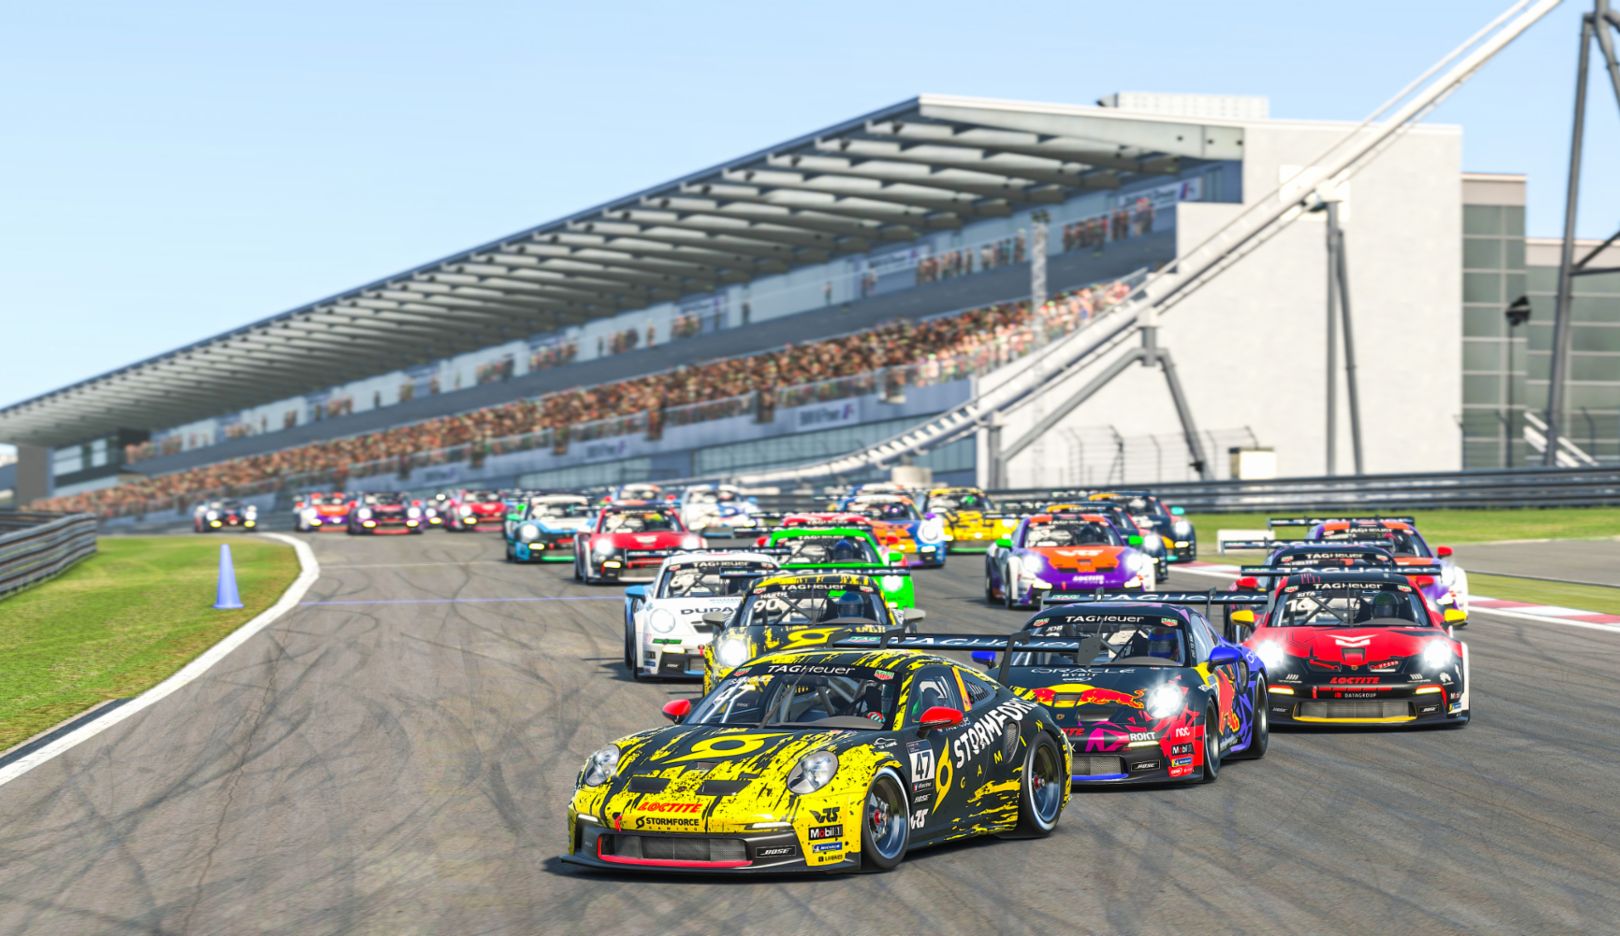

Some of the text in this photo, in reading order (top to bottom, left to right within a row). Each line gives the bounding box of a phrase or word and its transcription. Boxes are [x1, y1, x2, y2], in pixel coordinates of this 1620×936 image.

[1329, 677, 1381, 685] LOCTITE
[915, 750, 932, 780] 47
[637, 801, 703, 814] LOCTITE
[646, 816, 700, 827] STORMFORCE
[810, 827, 835, 839] Mobil
